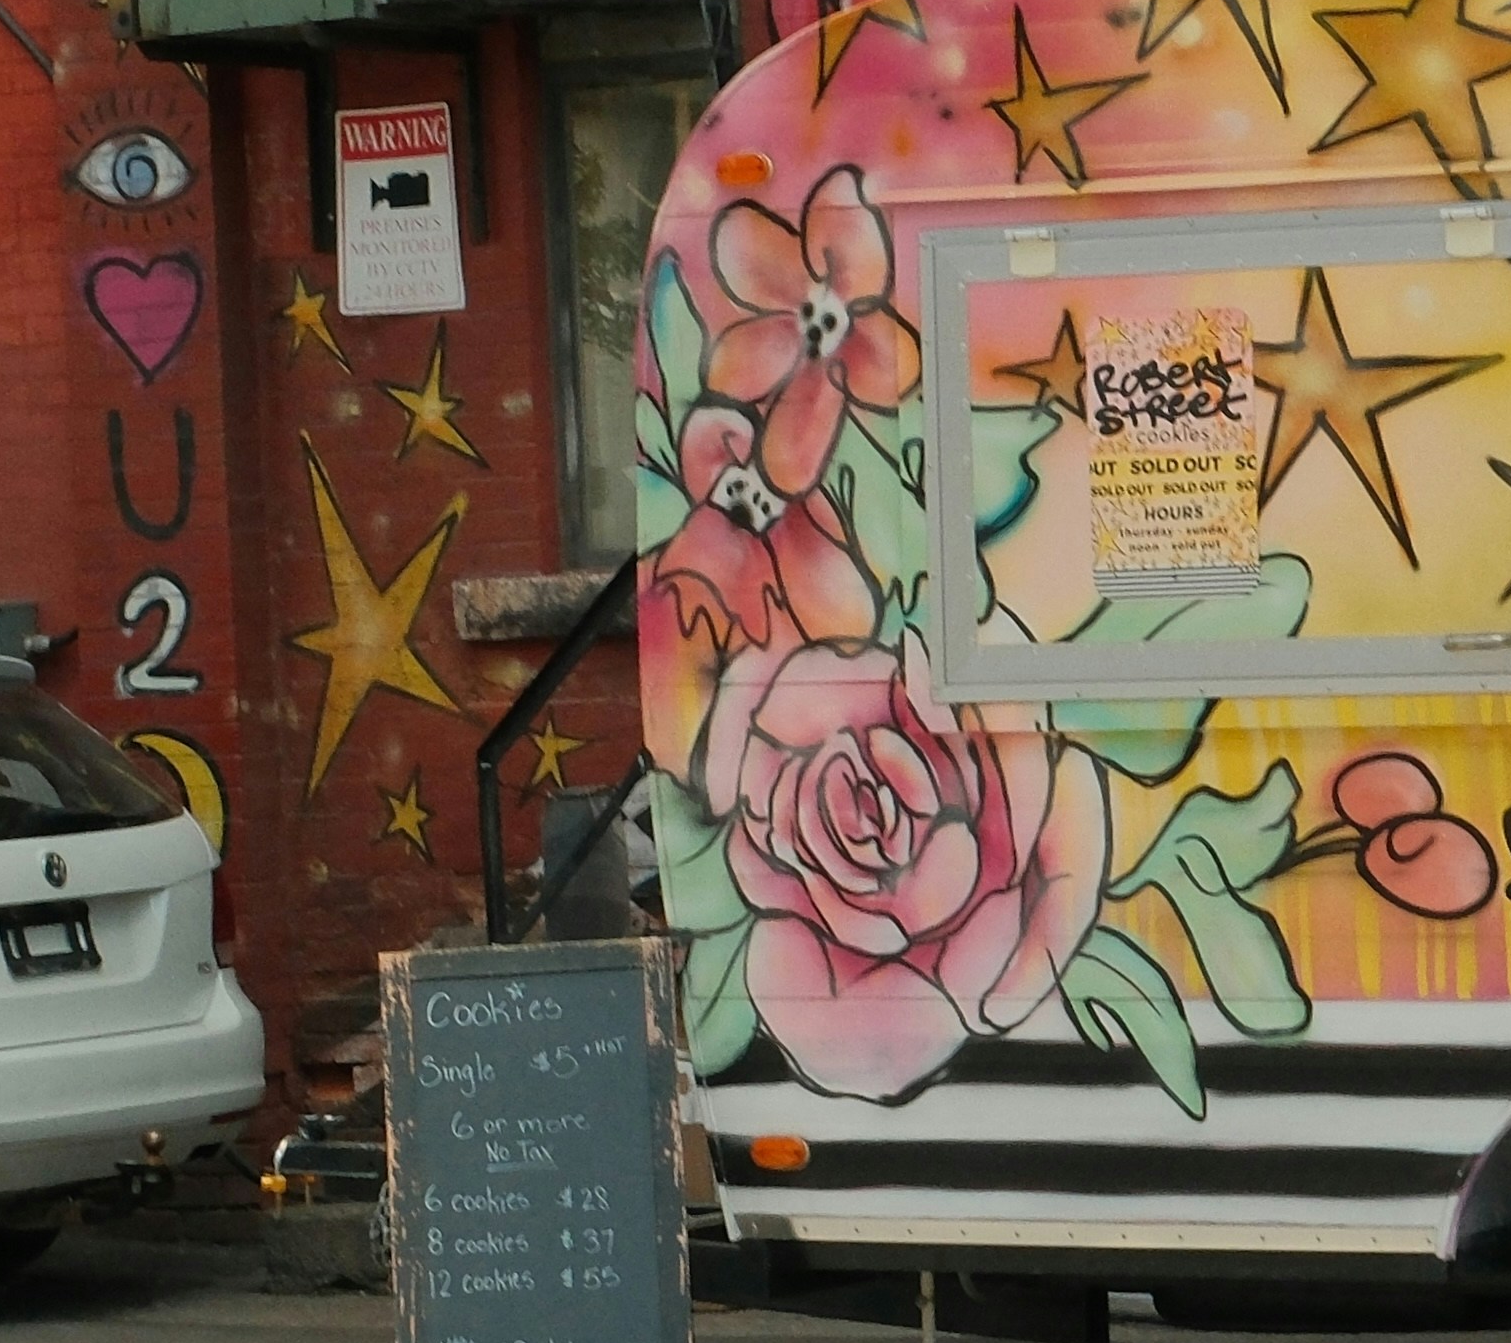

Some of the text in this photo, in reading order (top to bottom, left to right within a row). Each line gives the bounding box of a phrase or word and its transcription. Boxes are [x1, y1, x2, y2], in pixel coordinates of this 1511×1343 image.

[343, 115, 447, 153] WARNING
[359, 215, 442, 235] PREMISES
[349, 236, 452, 257] MONITORED
[365, 259, 438, 276] BY CCTV
[1136, 423, 1210, 445] cookies
[1090, 460, 1117, 476] UT
[1130, 458, 1179, 475] SOLD
[1183, 456, 1221, 473] OUT
[1091, 484, 1125, 498] SOLD
[1127, 483, 1154, 496] OUT
[1163, 481, 1198, 495] SOLD
[1199, 480, 1227, 493] OUT
[1144, 505, 1204, 521] HOURS
[114, 571, 200, 699] 2
[426, 981, 563, 1028] Cookies
[419, 1050, 496, 1098] Single
[451, 1110, 590, 1141] 6 or more
[485, 1140, 510, 1163] No
[424, 1183, 443, 1212] 6
[451, 1185, 531, 1215] cookies
[428, 1226, 444, 1256] 8
[454, 1231, 531, 1255] cookies
[428, 1268, 452, 1300] 12
[462, 1267, 536, 1295] cookies
